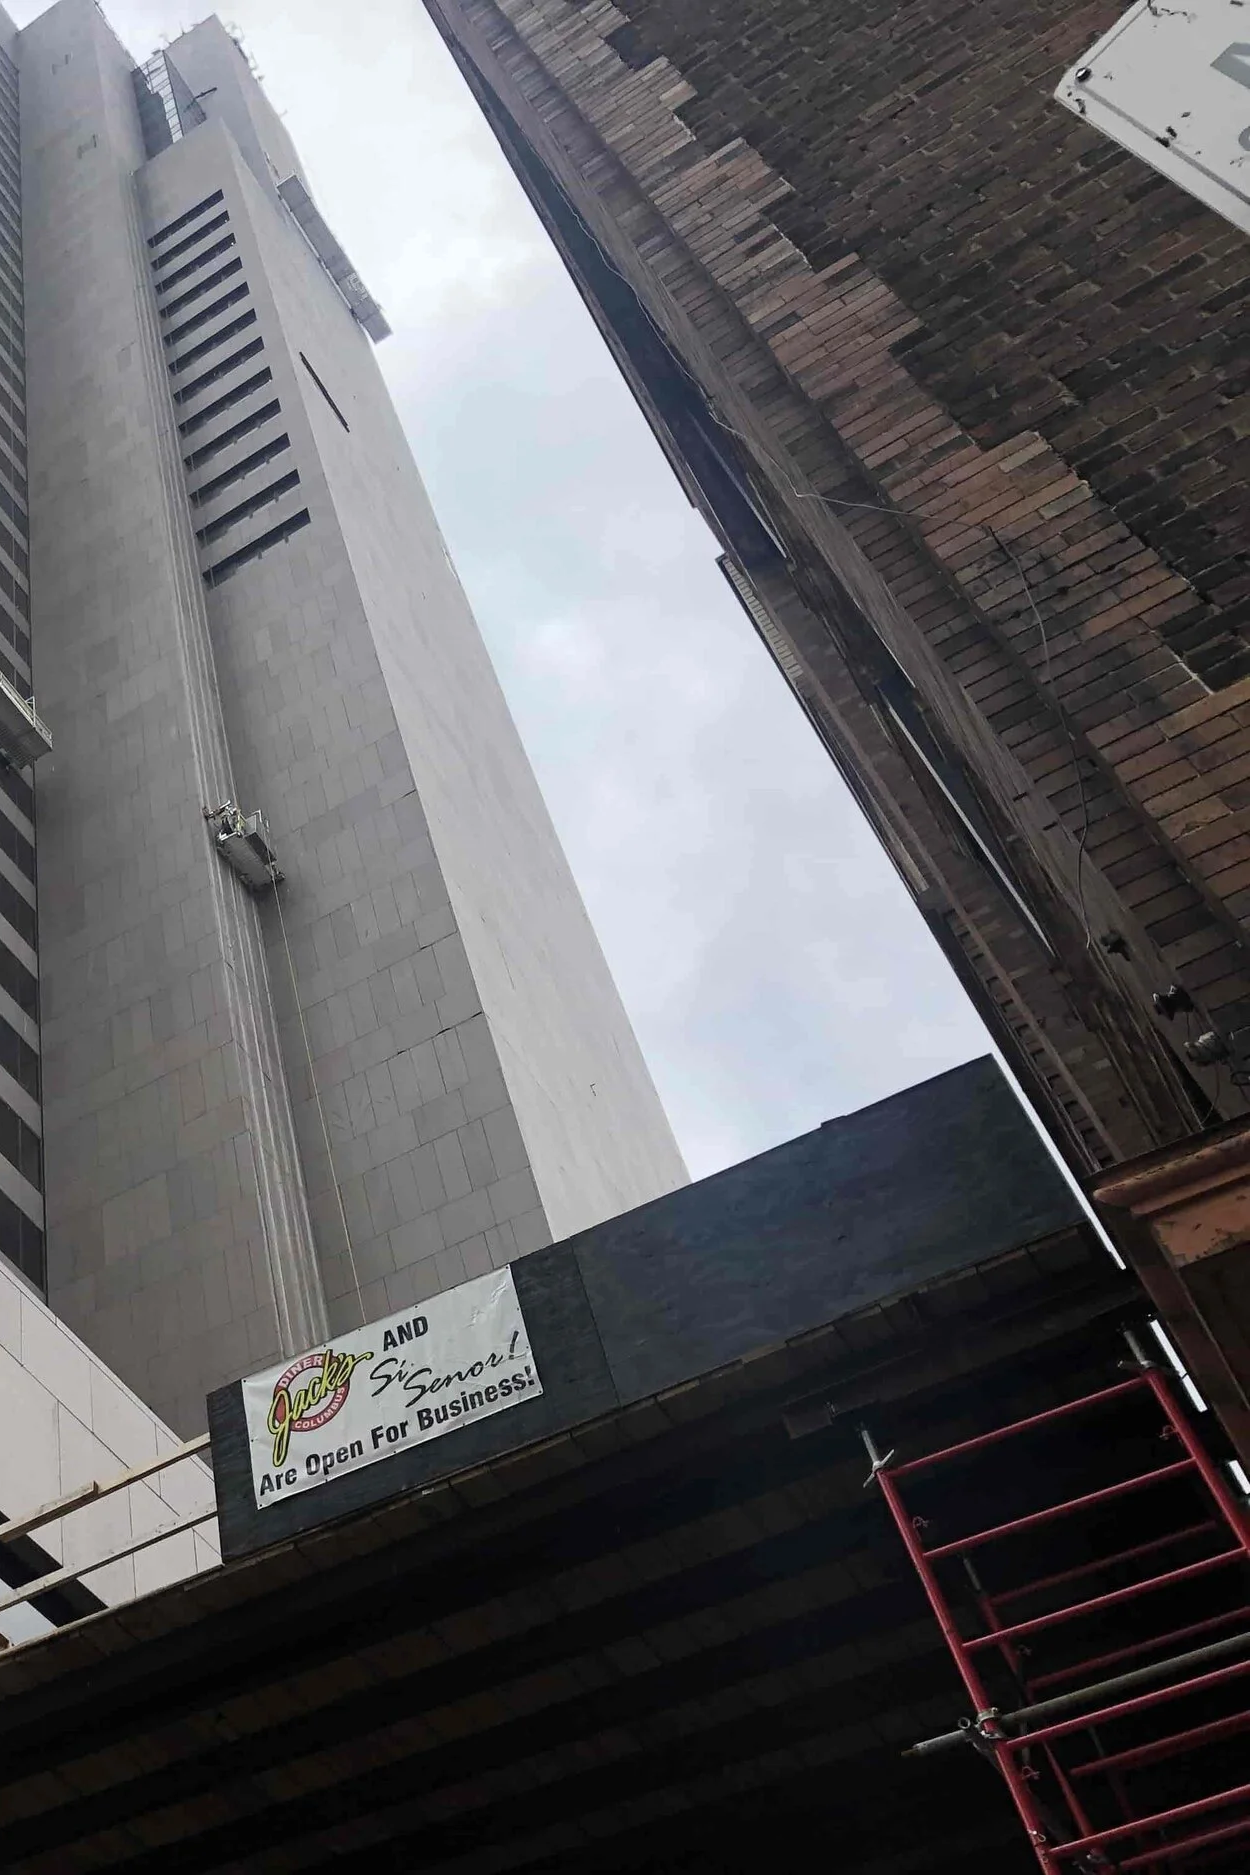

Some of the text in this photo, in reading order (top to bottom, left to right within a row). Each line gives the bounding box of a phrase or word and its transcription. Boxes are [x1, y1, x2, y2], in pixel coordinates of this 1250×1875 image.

[383, 1316, 429, 1351] AND
[278, 1355, 324, 1388] DINER
[267, 1349, 375, 1467] Jack's
[293, 1386, 346, 1429] COLUMBUS
[260, 1365, 536, 1496] Are Open For Business!
